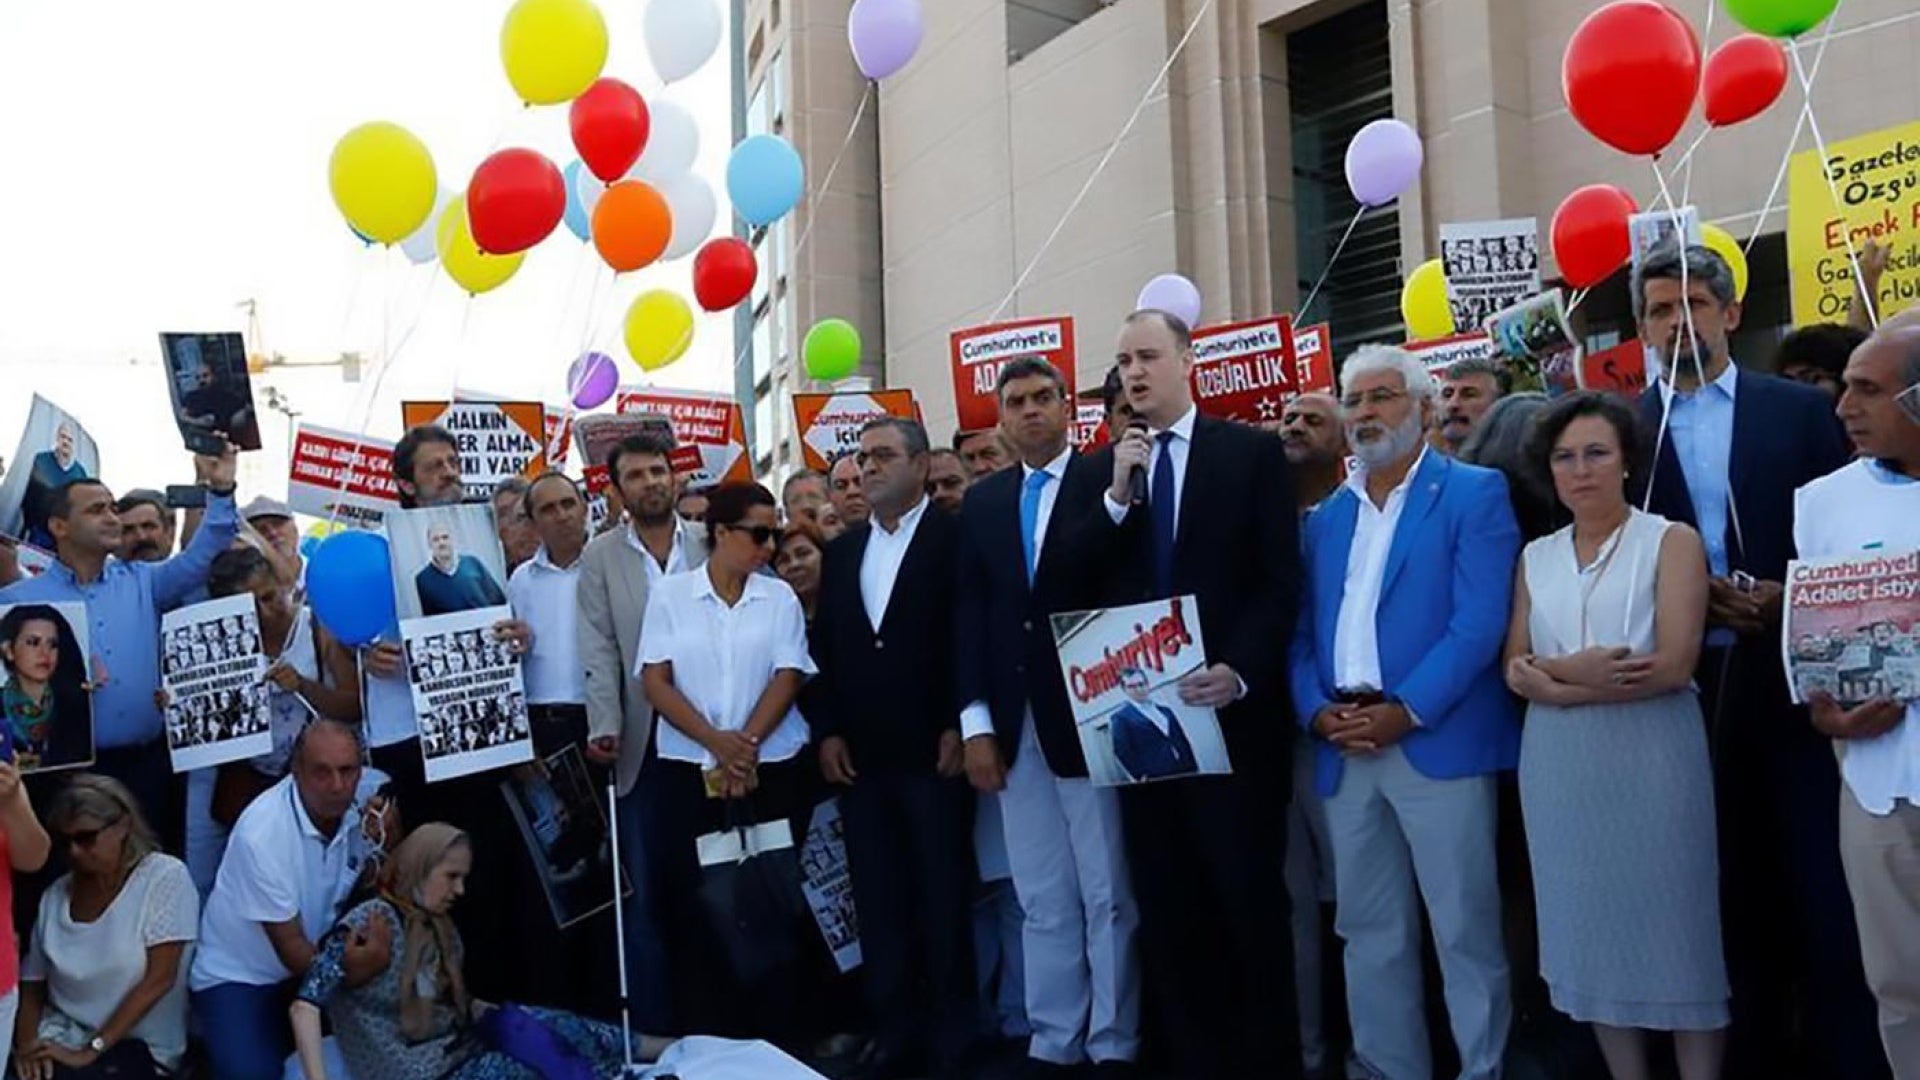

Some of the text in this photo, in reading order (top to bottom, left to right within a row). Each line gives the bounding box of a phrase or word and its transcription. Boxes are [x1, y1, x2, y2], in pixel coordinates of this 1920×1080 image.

[1825, 208, 1900, 249] Emek
[1196, 353, 1288, 398] ÖZGÜRLÜK
[447, 411, 507, 430] HALKIN
[486, 433, 533, 453] ALMA
[1794, 581, 1869, 605] Adalet
[1070, 597, 1192, 702] Cumhuriyet
